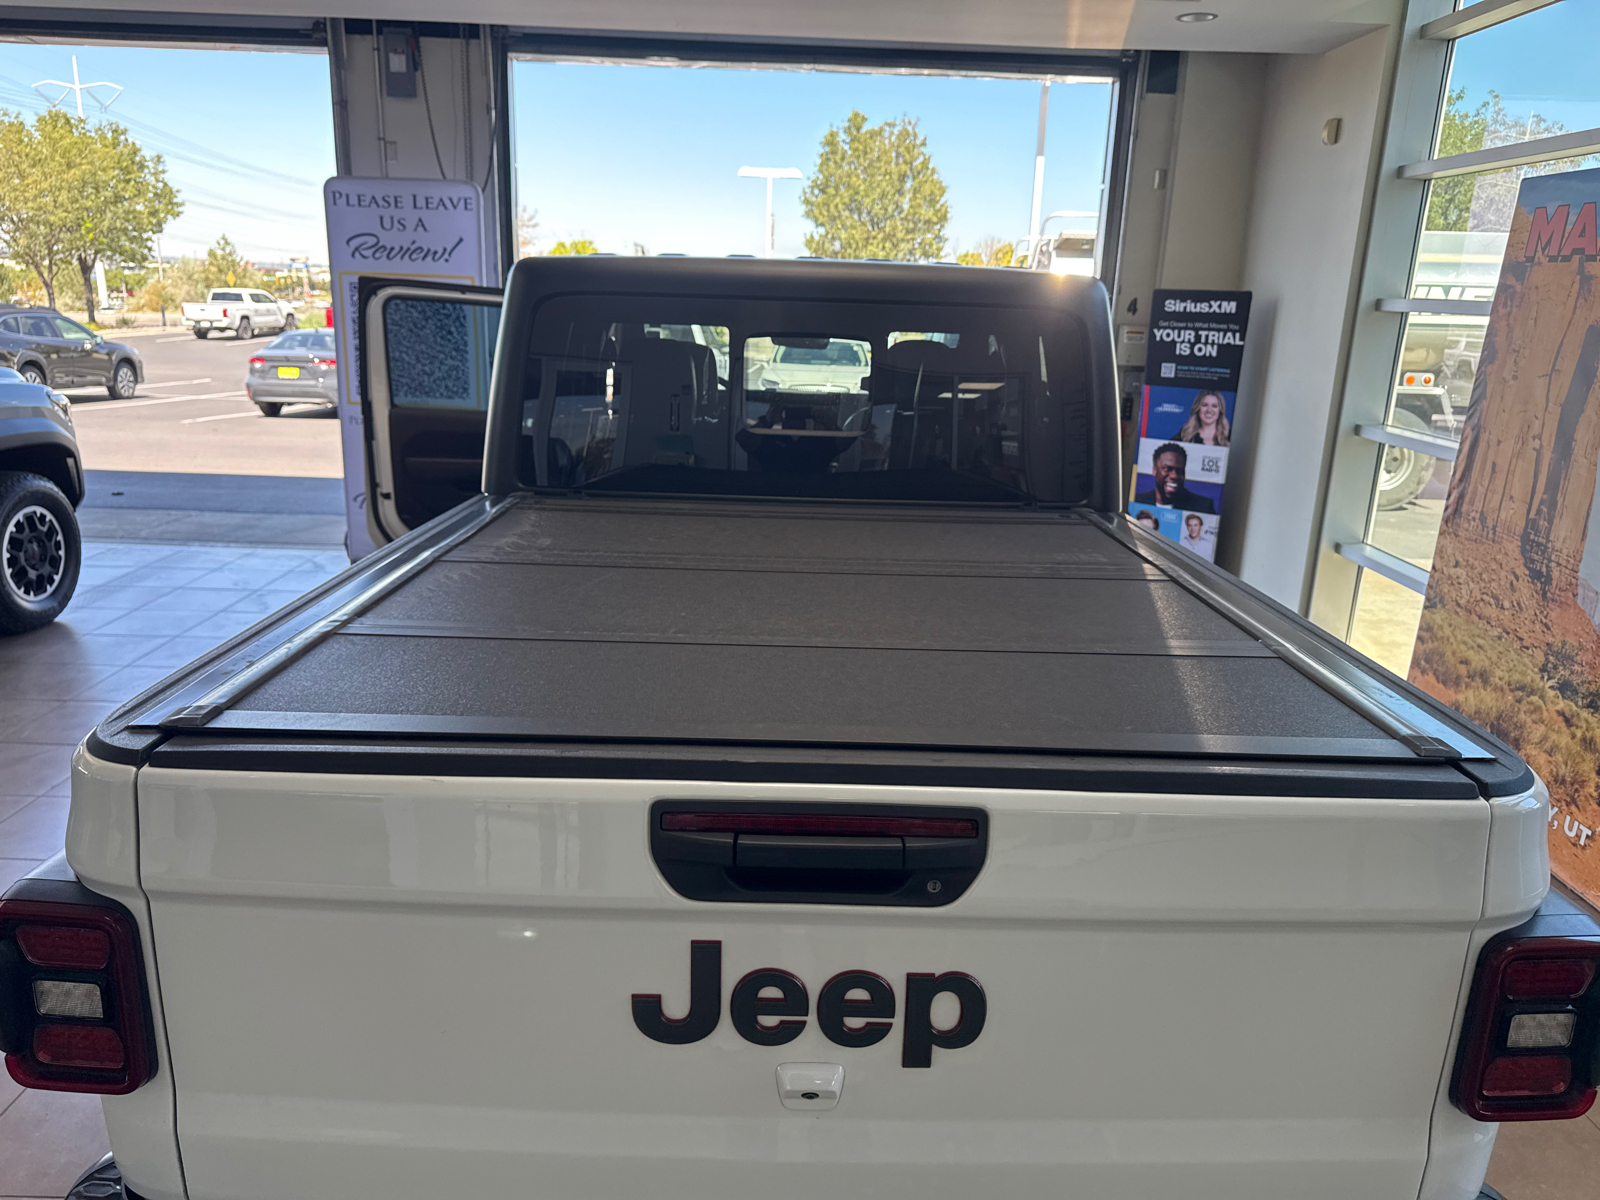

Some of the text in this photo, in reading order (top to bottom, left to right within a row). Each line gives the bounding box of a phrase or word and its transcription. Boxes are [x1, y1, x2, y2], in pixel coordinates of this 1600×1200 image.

[331, 189, 474, 212] PLEASE LEAVE
[378, 214, 430, 233] US A
[345, 232, 464, 263] Review!
[1126, 297, 1138, 316] 4
[1164, 299, 1237, 314] SiriusXM
[1158, 319, 1169, 327] Get
[1169, 320, 1187, 328] Closer
[1209, 322, 1228, 330] Moves
[1228, 323, 1240, 331] You
[1153, 328, 1195, 343] YOUR
[1198, 330, 1244, 345] TRIAL
[1175, 342, 1218, 357] IS ON
[1202, 458, 1220, 468] LOL
[1563, 814, 1592, 846] UT
[631, 939, 988, 1069] Jeep
